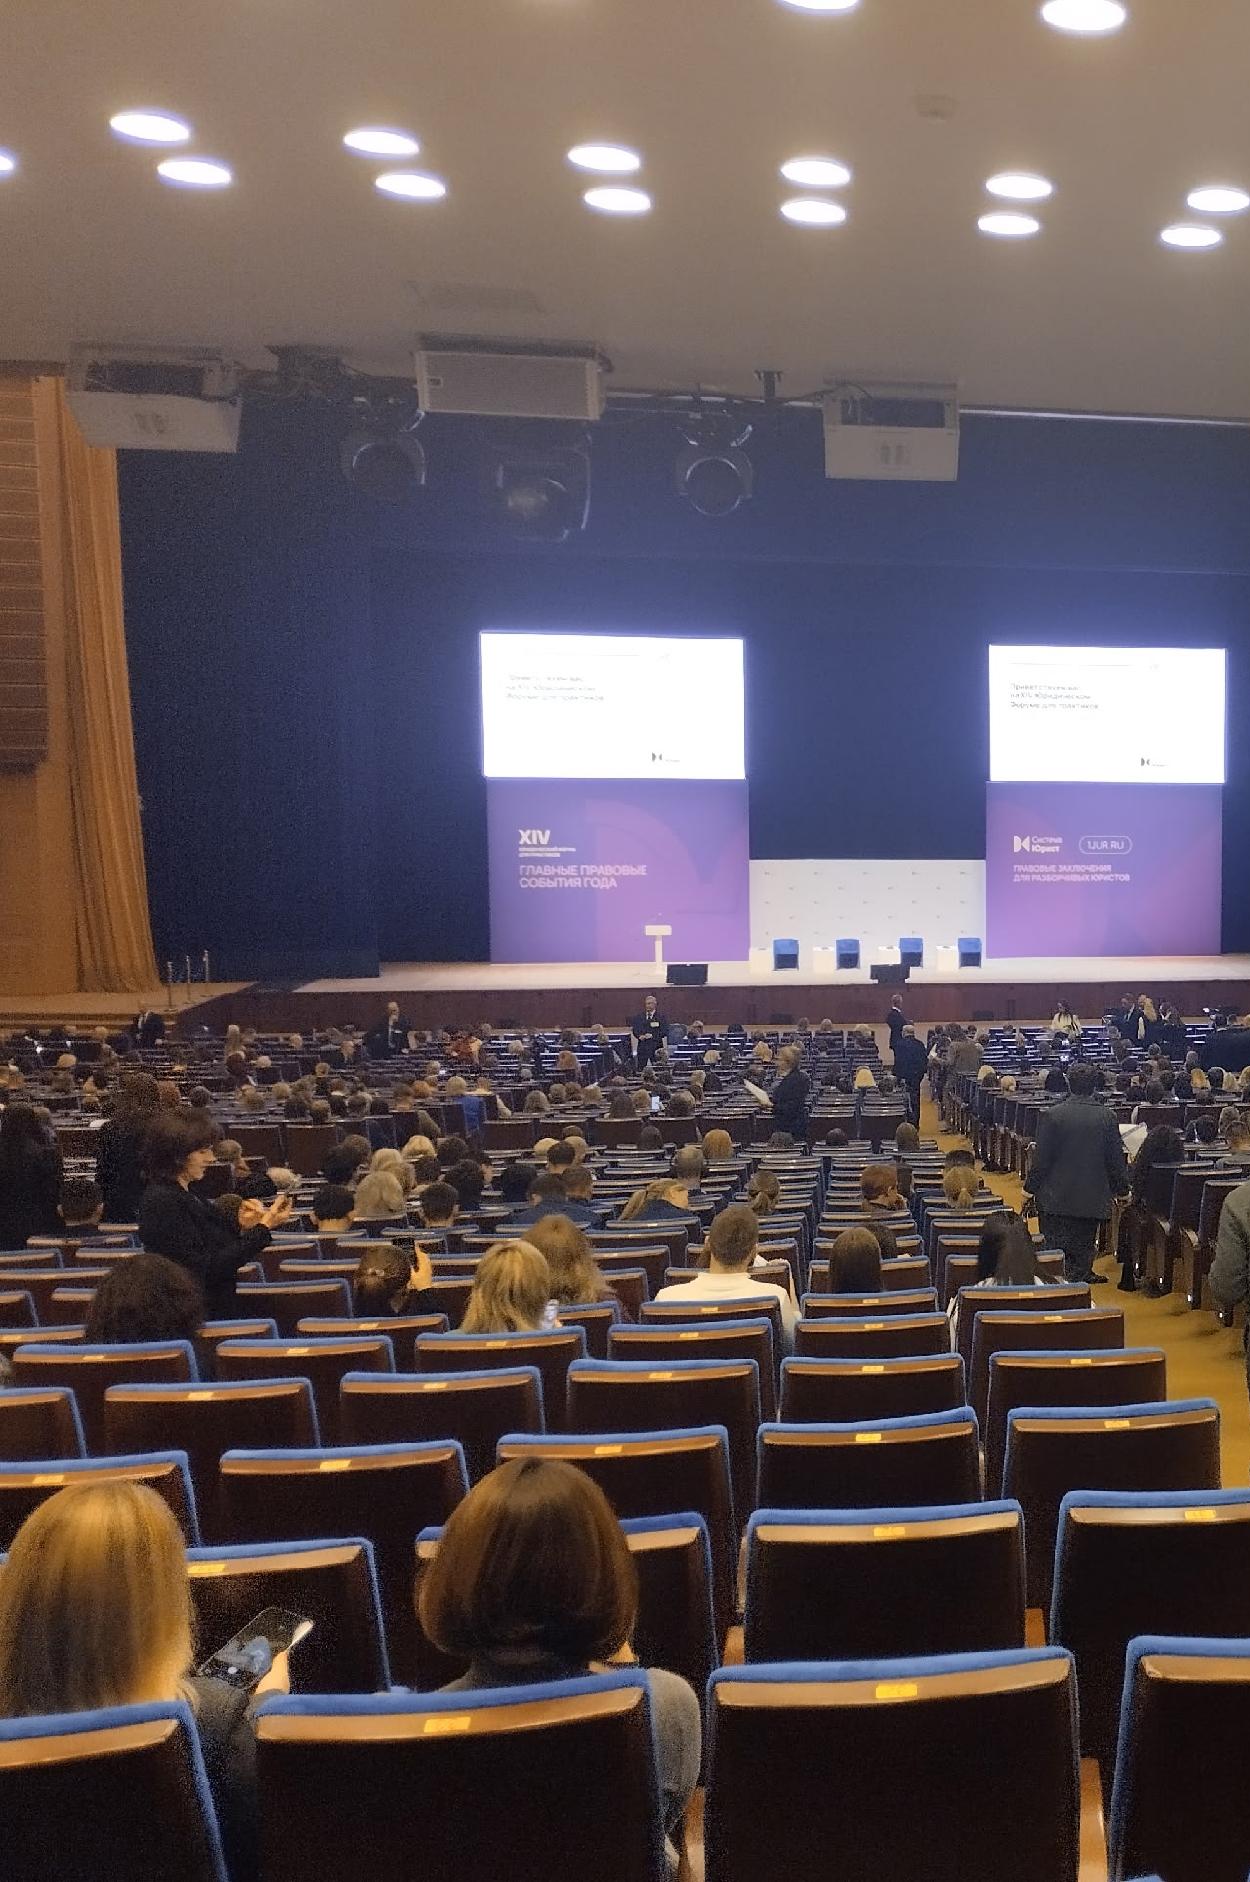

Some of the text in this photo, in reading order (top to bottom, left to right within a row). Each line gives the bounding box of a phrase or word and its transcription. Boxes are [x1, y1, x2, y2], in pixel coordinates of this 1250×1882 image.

[519, 829, 551, 845] XIV
[1031, 844, 1060, 854] Юрист
[519, 864, 648, 876] ГЛАВНЫЕ ПРАВОВЫЕ
[519, 877, 618, 890] СОБЫТИЯ ГОДА
